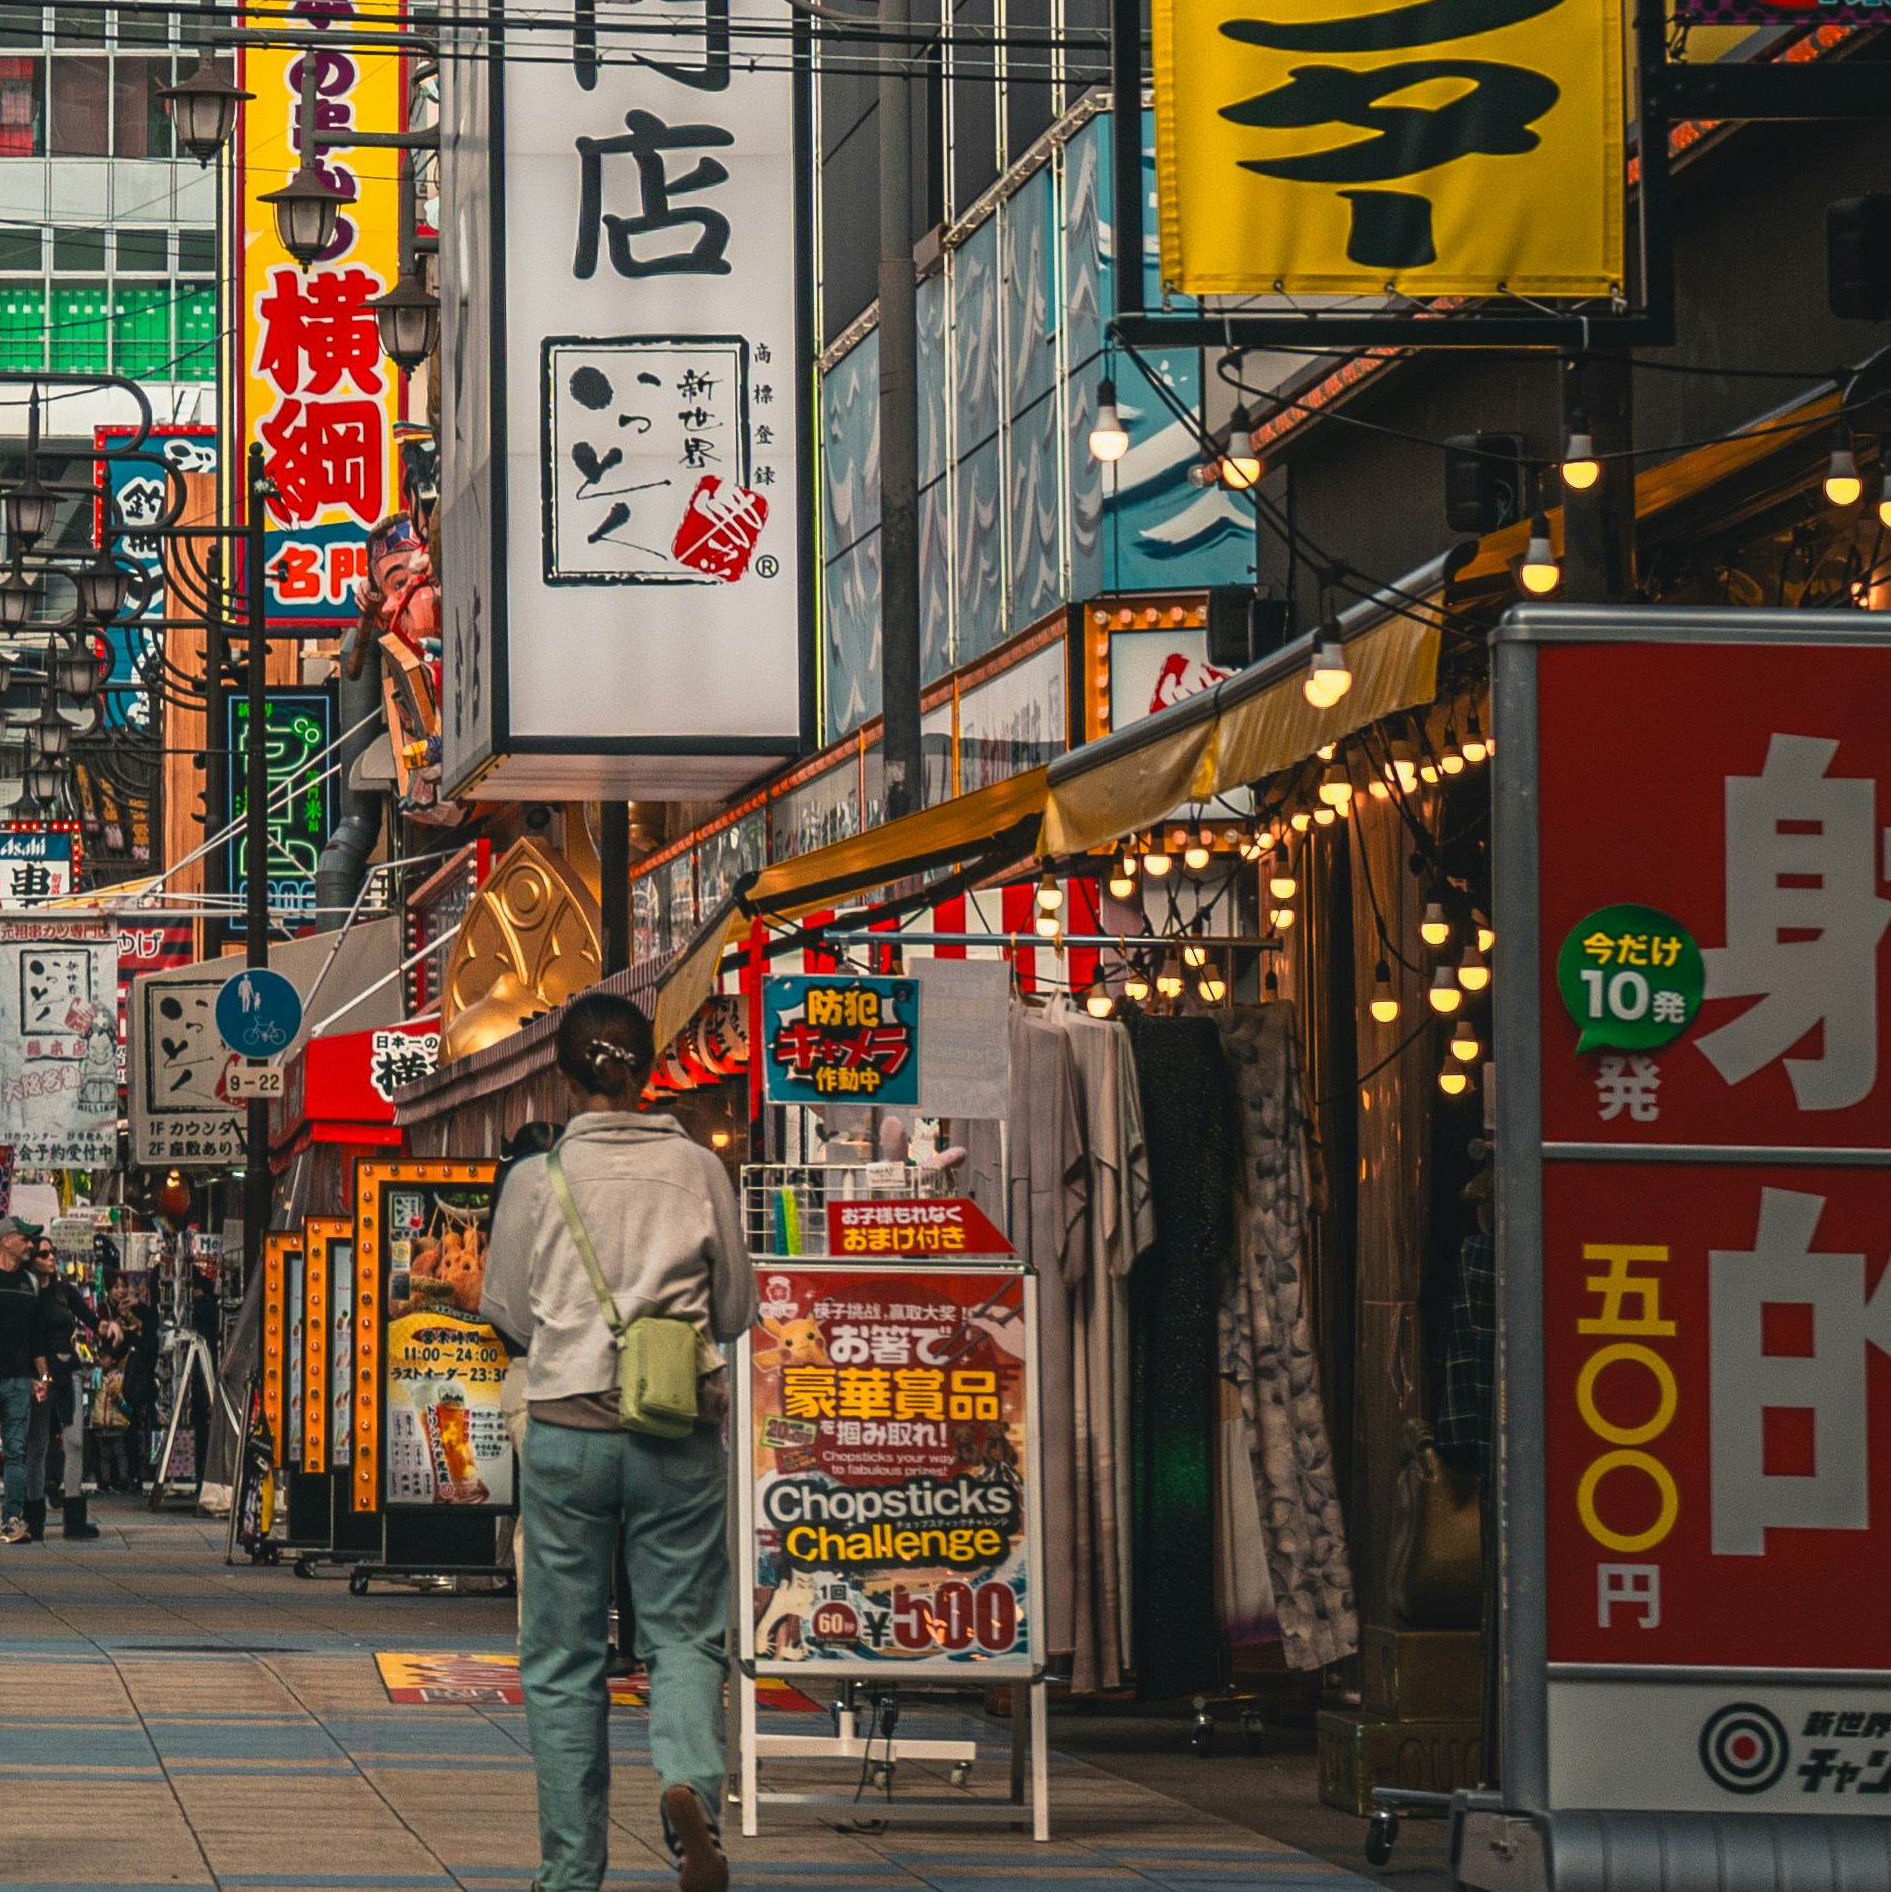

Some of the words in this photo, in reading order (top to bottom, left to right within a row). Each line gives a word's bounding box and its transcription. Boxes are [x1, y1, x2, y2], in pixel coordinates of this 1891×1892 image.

[258, 269, 384, 525] 横綱
[676, 369, 725, 469] 新世界
[753, 342, 776, 487] 商標登録
[0, 837, 47, 857] Asahi
[1582, 931, 1683, 967] 今だけ
[807, 989, 880, 1028] 防犯
[1580, 969, 1686, 1025] 10発
[230, 1073, 280, 1092] 9-22
[815, 1066, 881, 1092] 作動中
[1595, 1055, 1662, 1123] 発
[148, 1120, 164, 1136] 1F
[148, 1140, 164, 1157] 2F
[841, 1205, 963, 1225] お子様もれなく
[843, 1226, 966, 1251] おまけ付き
[830, 1324, 953, 1365] お箸で
[782, 1366, 1001, 1421] 豪華賞品
[819, 1420, 948, 1448] を掴み取れ!
[822, 1450, 894, 1464] Chopsticks
[897, 1454, 926, 1465] your
[928, 1455, 956, 1466] way
[831, 1465, 845, 1475] to
[847, 1465, 903, 1476] fabulous
[768, 1479, 1014, 1525] Chopsticks
[785, 1522, 1002, 1564] Challenge
[819, 1584, 847, 1601] 1回
